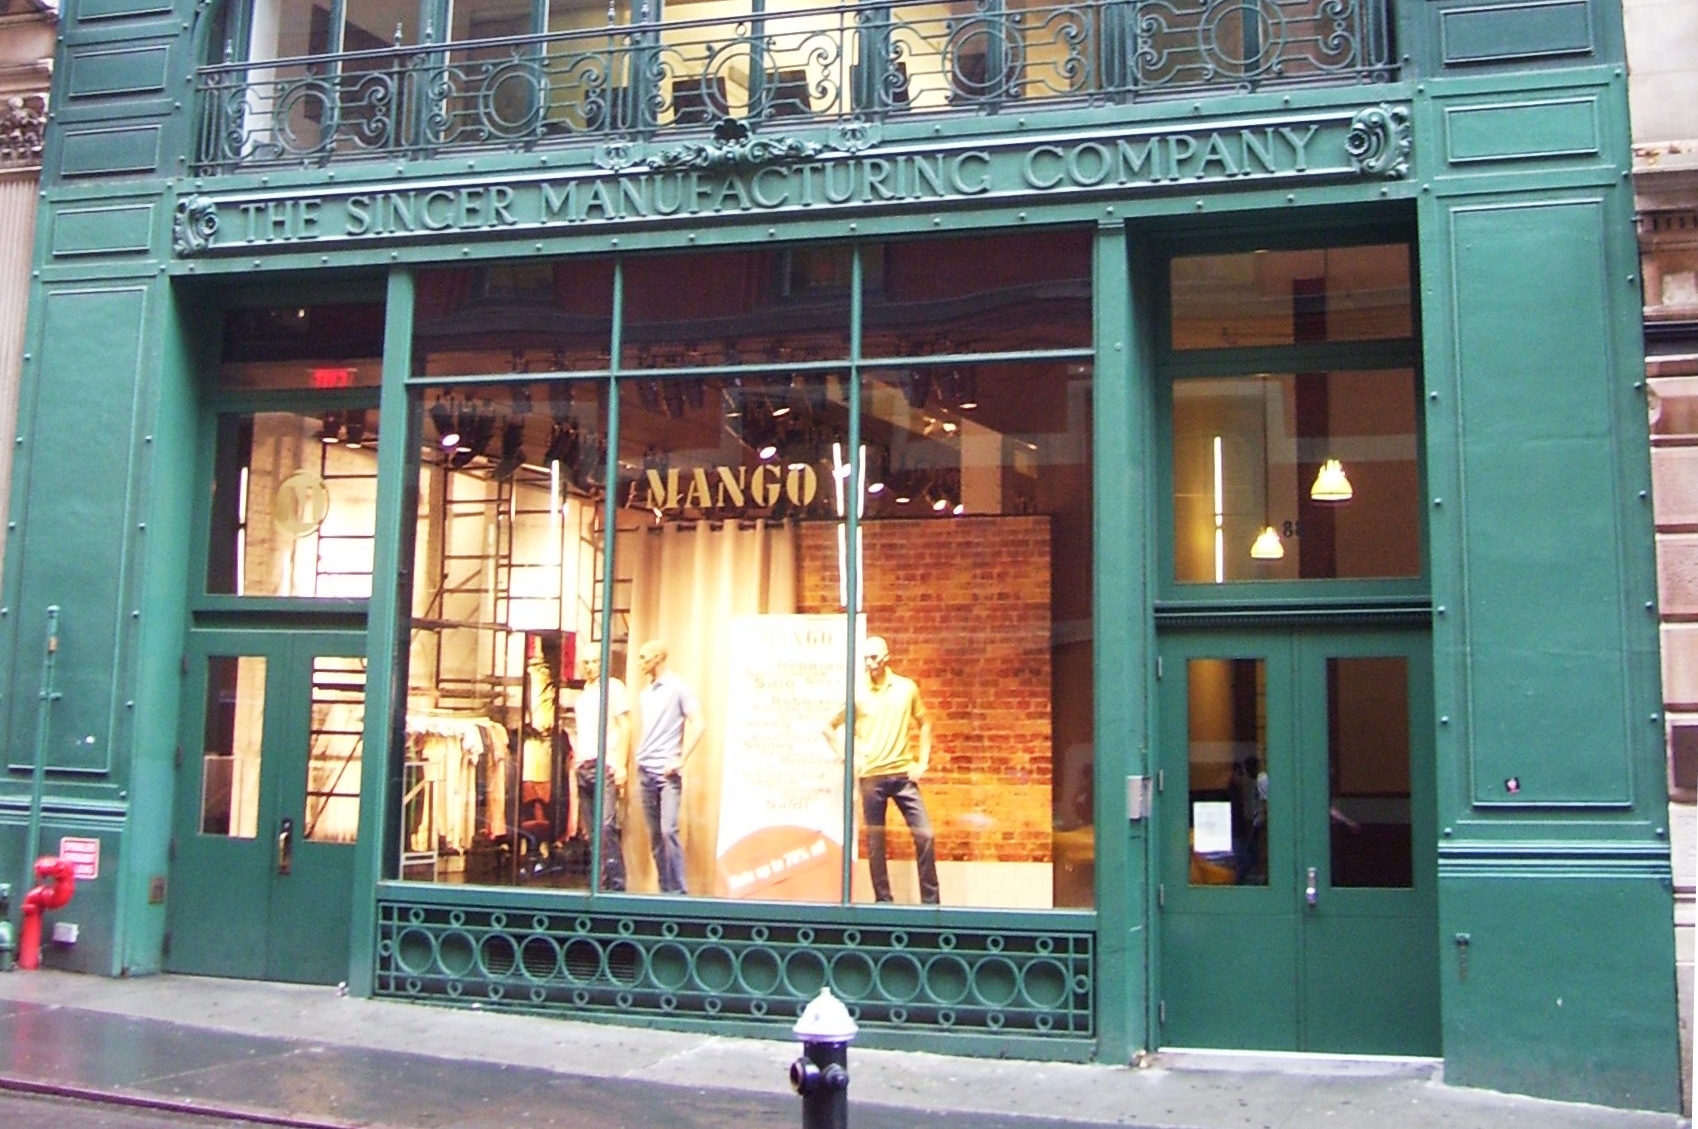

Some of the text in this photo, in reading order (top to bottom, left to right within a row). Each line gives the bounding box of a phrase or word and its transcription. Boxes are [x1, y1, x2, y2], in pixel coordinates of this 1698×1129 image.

[240, 124, 1320, 243] THE SINGER MANUFACTURING COMPANY
[646, 464, 818, 509] MANGO
